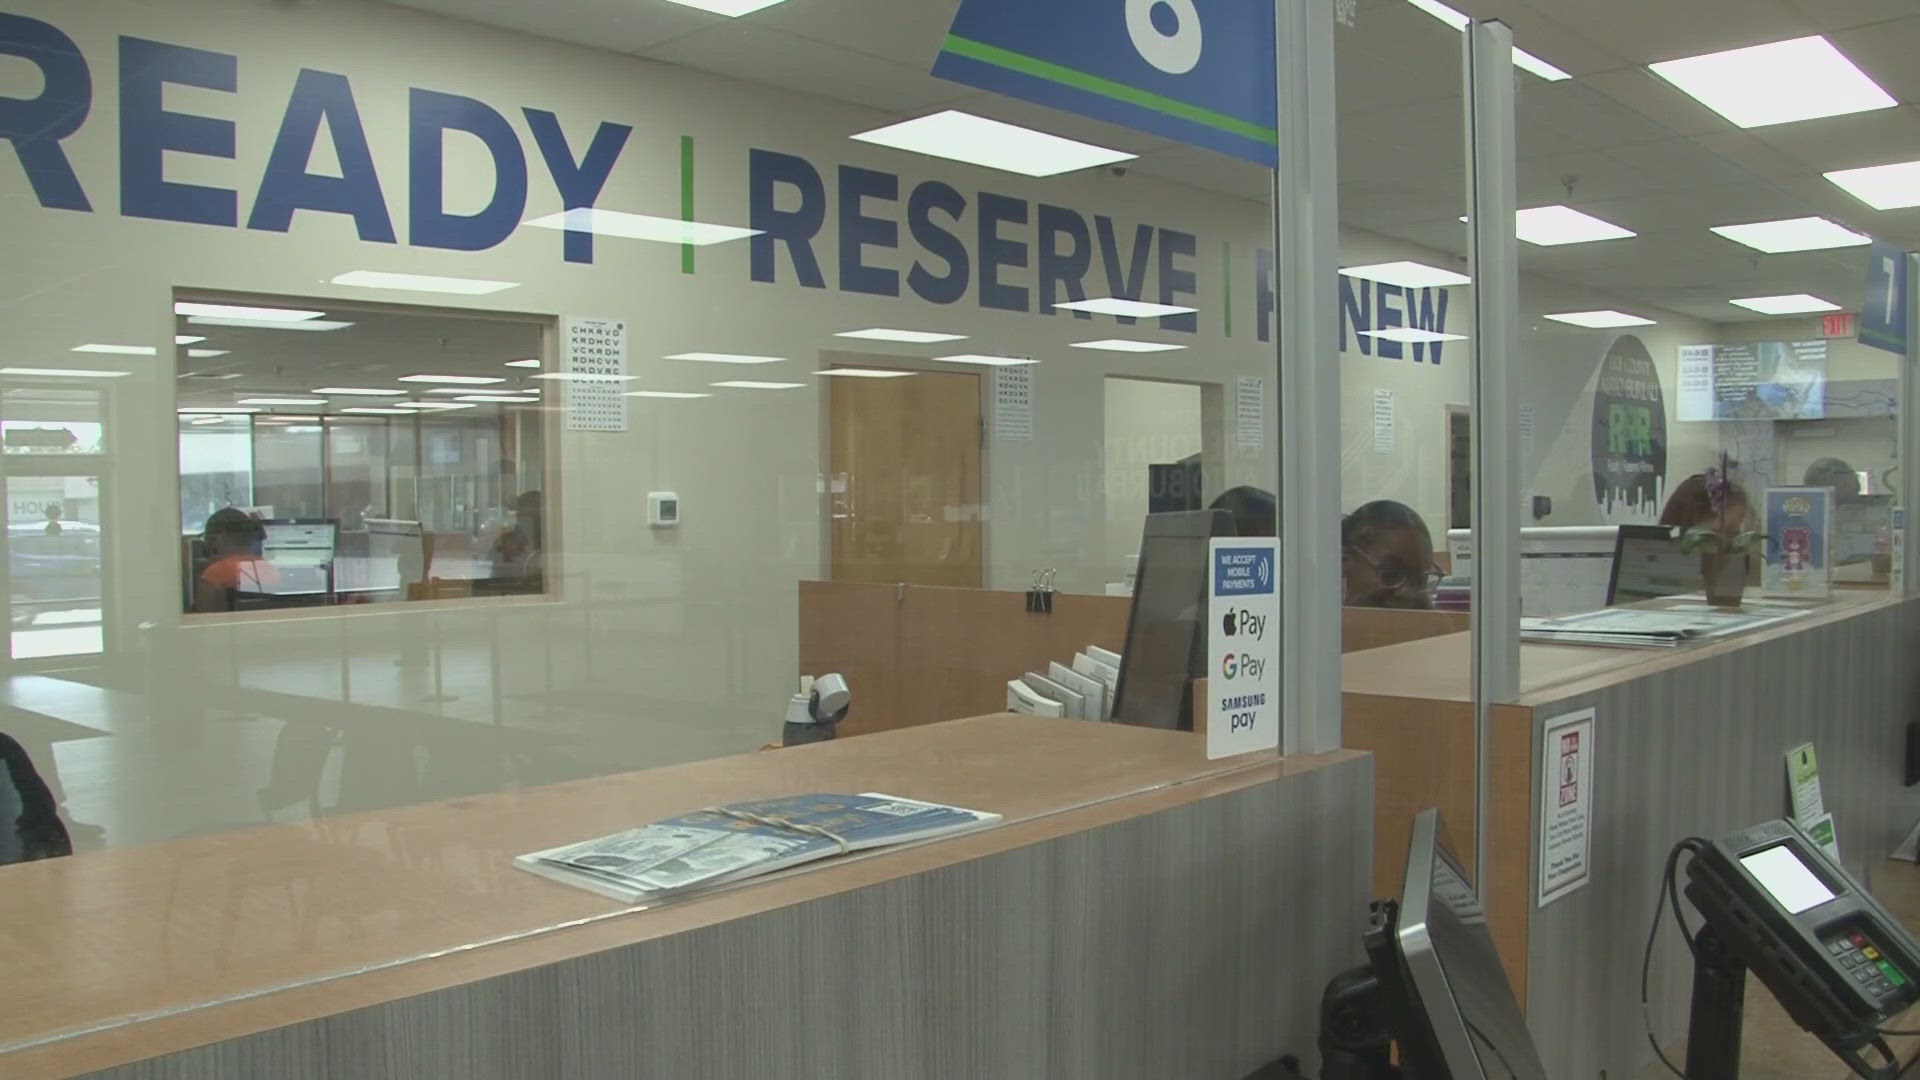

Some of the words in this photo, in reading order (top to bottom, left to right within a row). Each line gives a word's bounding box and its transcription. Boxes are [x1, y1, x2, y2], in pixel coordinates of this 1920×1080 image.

[0, 11, 633, 264] READY
[748, 147, 1197, 334] RESERVE
[1221, 555, 1232, 565] WE
[1232, 554, 1257, 565] ACCEPT
[1227, 567, 1251, 577] MOBILE
[1222, 579, 1255, 589] PAYMENTS
[1240, 609, 1267, 642] Pay
[1241, 653, 1266, 682] Pay
[1221, 693, 1266, 711] SAMSUNG
[1231, 711, 1256, 734] pay
